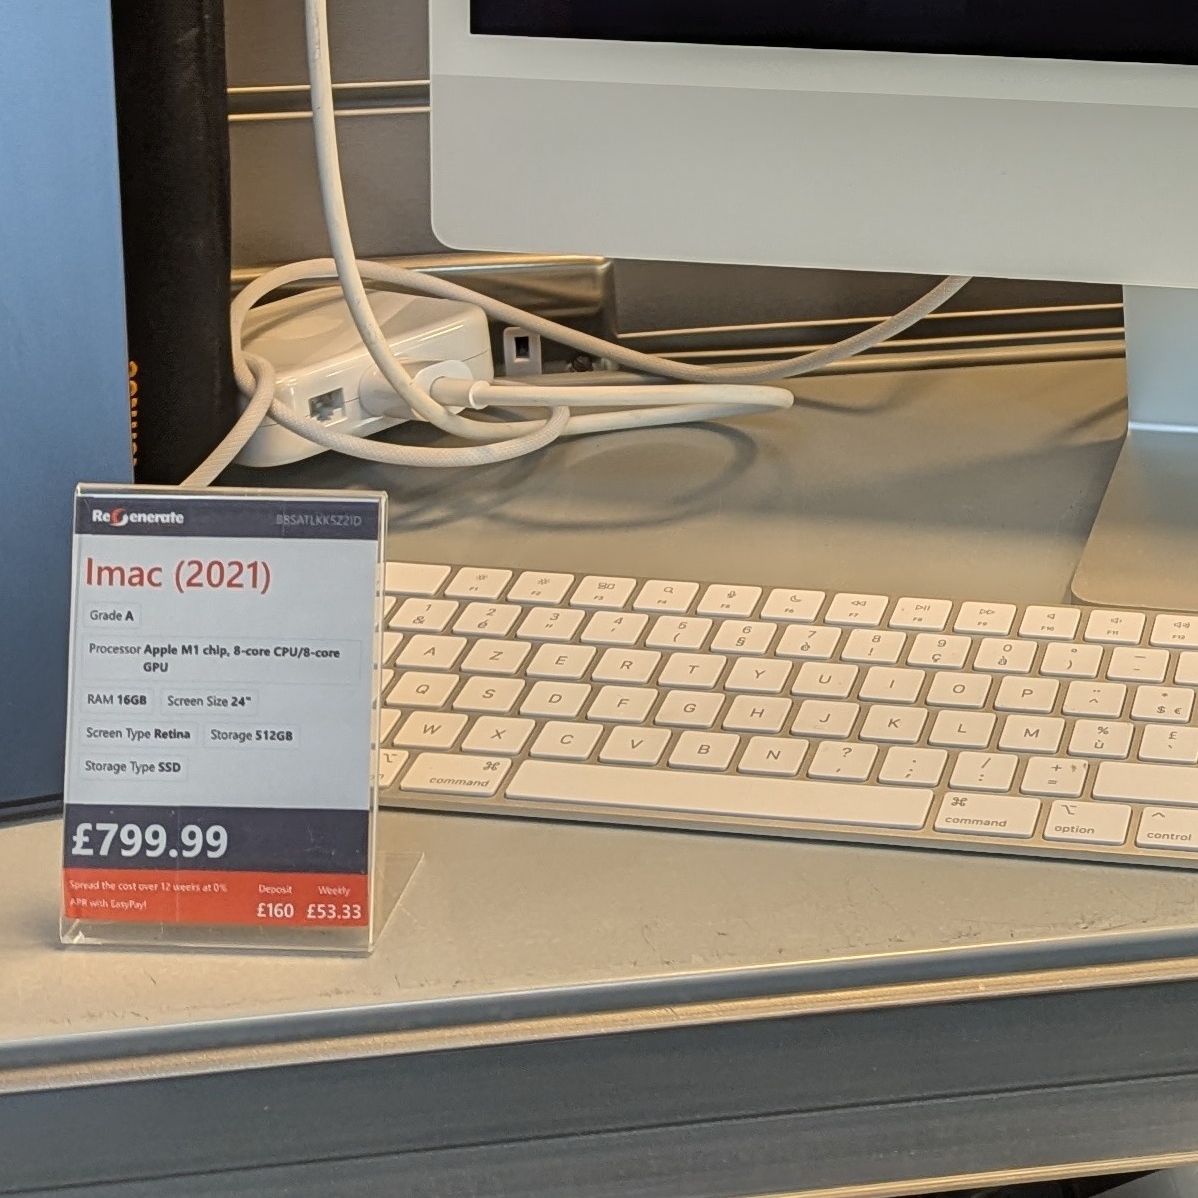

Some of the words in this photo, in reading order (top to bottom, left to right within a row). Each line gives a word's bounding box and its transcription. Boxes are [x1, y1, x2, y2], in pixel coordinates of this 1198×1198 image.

[86, 557, 163, 587] Imac
[175, 560, 270, 594] (2021)
[90, 610, 122, 621] Grade
[125, 611, 134, 621] A
[413, 616, 425, 624] &
[89, 643, 141, 654] Processor
[144, 644, 178, 657] Apple
[181, 645, 199, 655] M1
[233, 646, 271, 656] 8-core
[273, 647, 340, 658] CPU/8-core
[424, 647, 435, 656] A
[1003, 644, 1012, 652] 0
[489, 651, 503, 660] Z
[555, 656, 567, 665] E
[620, 661, 633, 669] R
[143, 662, 168, 672] GPU
[689, 665, 699, 674] T
[755, 670, 765, 678] Y
[819, 675, 832, 684] U
[890, 680, 894, 688] I
[416, 685, 429, 694] Q
[482, 689, 495, 698] S
[953, 685, 965, 693] O
[1022, 689, 1033, 697] P
[88, 695, 113, 705] RAM
[118, 695, 147, 706] 16GB
[168, 695, 203, 707] Screen
[208, 696, 228, 707] Size
[549, 694, 562, 703] D
[617, 699, 629, 707] F
[684, 704, 696, 713] G
[750, 708, 764, 718] H
[1156, 706, 1166, 716] $
[819, 714, 830, 722] J
[888, 719, 900, 728] K
[423, 724, 441, 734] W
[958, 724, 966, 733] L
[1098, 726, 1109, 734] %
[87, 728, 122, 739] Screen
[127, 728, 151, 741] Type
[154, 729, 191, 740] Retina
[211, 730, 252, 742] Storage
[256, 731, 293, 741] 512GB
[491, 730, 506, 739] X
[1024, 729, 1039, 738] M
[1169, 731, 1177, 739] £
[560, 735, 574, 744] C
[631, 739, 643, 749] V
[1094, 740, 1104, 749] ù
[698, 745, 710, 754] B
[843, 748, 852, 757] ?
[766, 750, 781, 760] N
[86, 761, 126, 774] Storage
[130, 762, 154, 774] Type
[158, 762, 181, 773] SSD
[430, 776, 490, 788] command
[945, 816, 1007, 828] command
[1055, 826, 1094, 834] option
[71, 823, 228, 858] £799.99
[70, 880, 99, 891] Spread
[102, 881, 115, 890] the
[118, 882, 137, 891] cost
[161, 882, 170, 891] 12
[173, 883, 200, 891] weeks
[203, 884, 211, 892] at
[258, 884, 292, 895] Deposit
[257, 902, 294, 918] £160
[307, 903, 361, 919] £53.33
